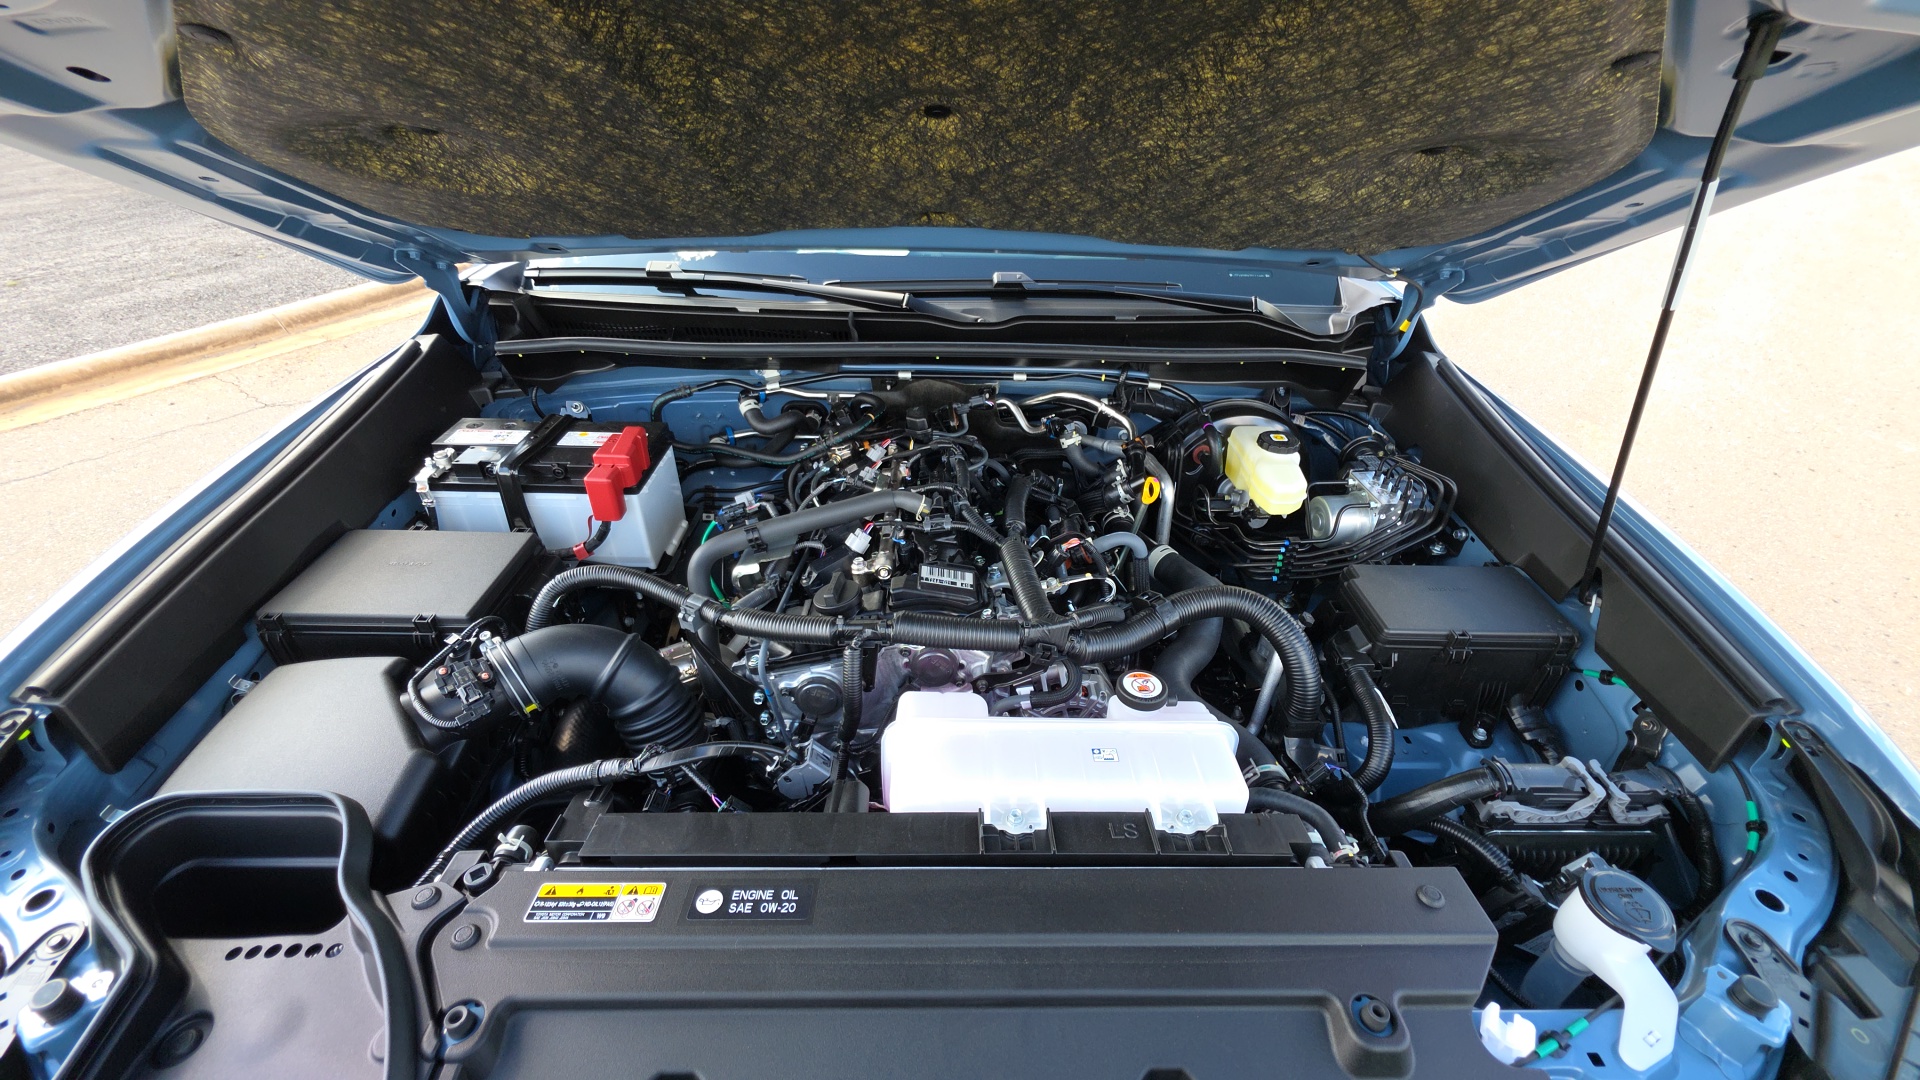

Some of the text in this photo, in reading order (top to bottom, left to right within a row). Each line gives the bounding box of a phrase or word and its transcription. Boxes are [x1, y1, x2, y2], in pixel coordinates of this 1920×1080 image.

[1108, 822, 1139, 839] LS
[731, 889, 799, 900] ENGINE OIL
[728, 902, 797, 914] SAE 0W-20
